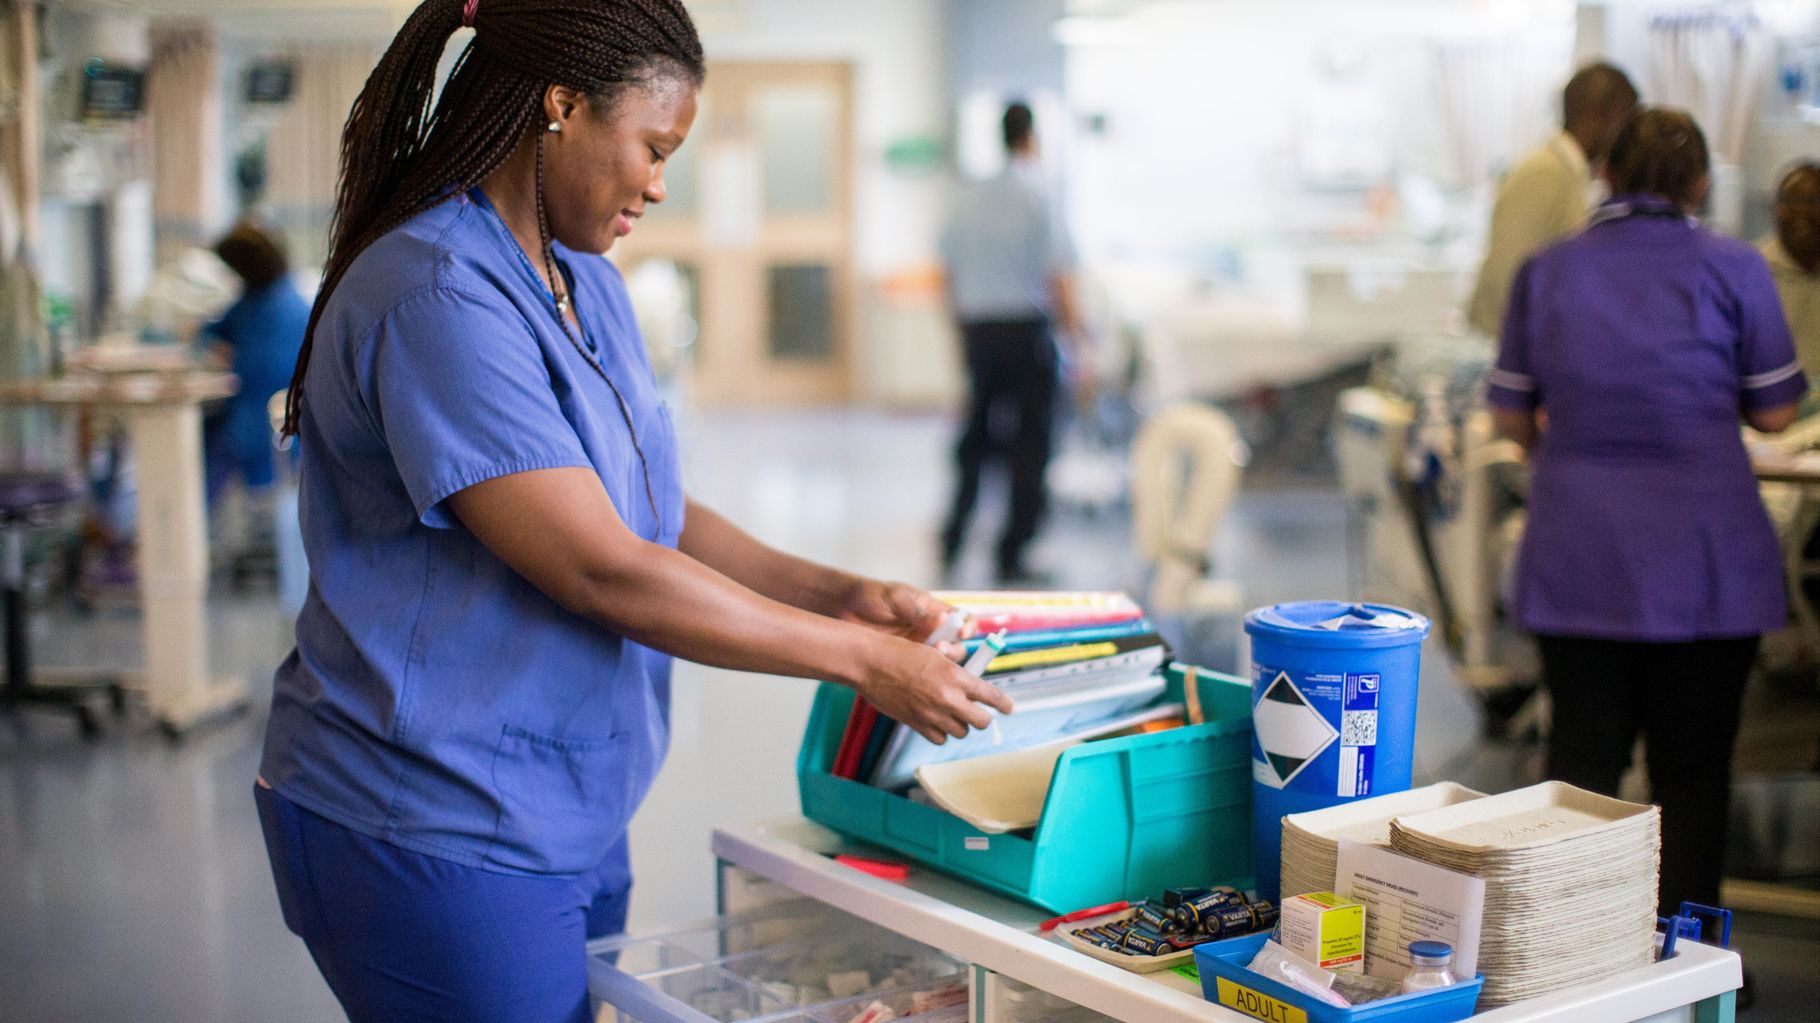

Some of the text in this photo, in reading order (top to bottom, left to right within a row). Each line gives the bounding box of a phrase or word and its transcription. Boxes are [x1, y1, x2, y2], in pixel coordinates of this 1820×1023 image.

[1195, 898, 1220, 911] VARTA
[1229, 910, 1251, 921] VARTA
[1127, 937, 1147, 950] VARTA
[1237, 989, 1288, 1023] ADULT
